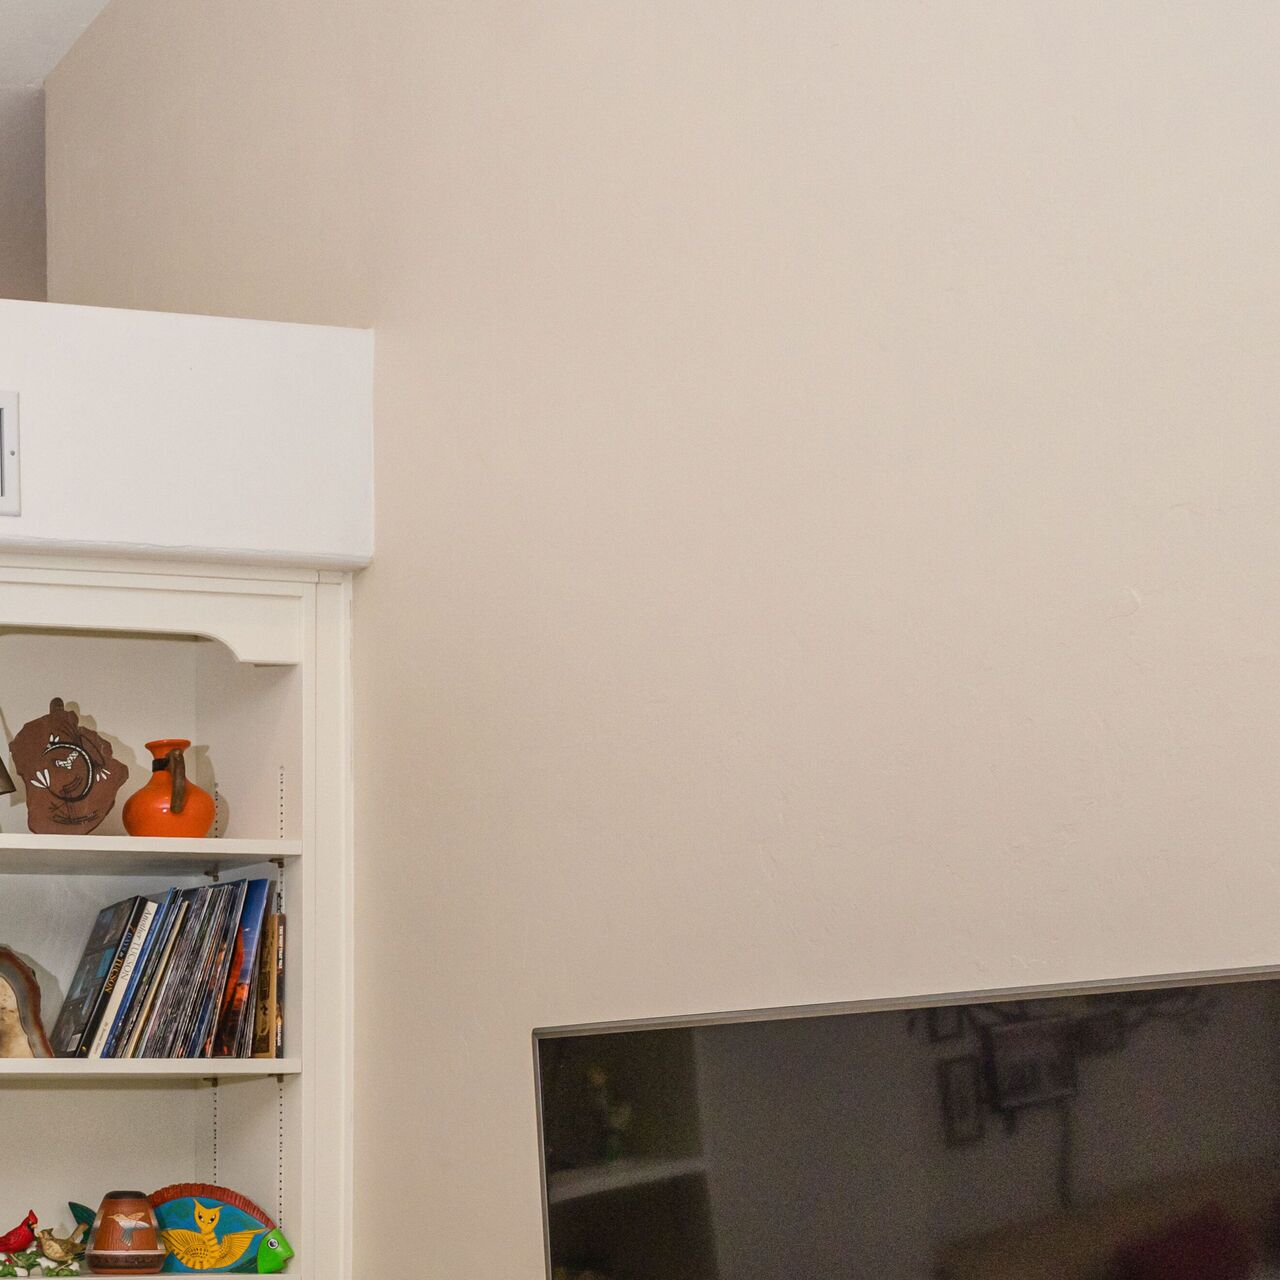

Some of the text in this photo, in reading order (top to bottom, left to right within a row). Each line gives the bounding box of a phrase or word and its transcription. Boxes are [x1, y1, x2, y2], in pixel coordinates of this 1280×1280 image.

[120, 932, 133, 952] DAYS
[135, 909, 153, 943] Another
[104, 957, 125, 994] TUCSON
[120, 943, 142, 982] TUCSON
